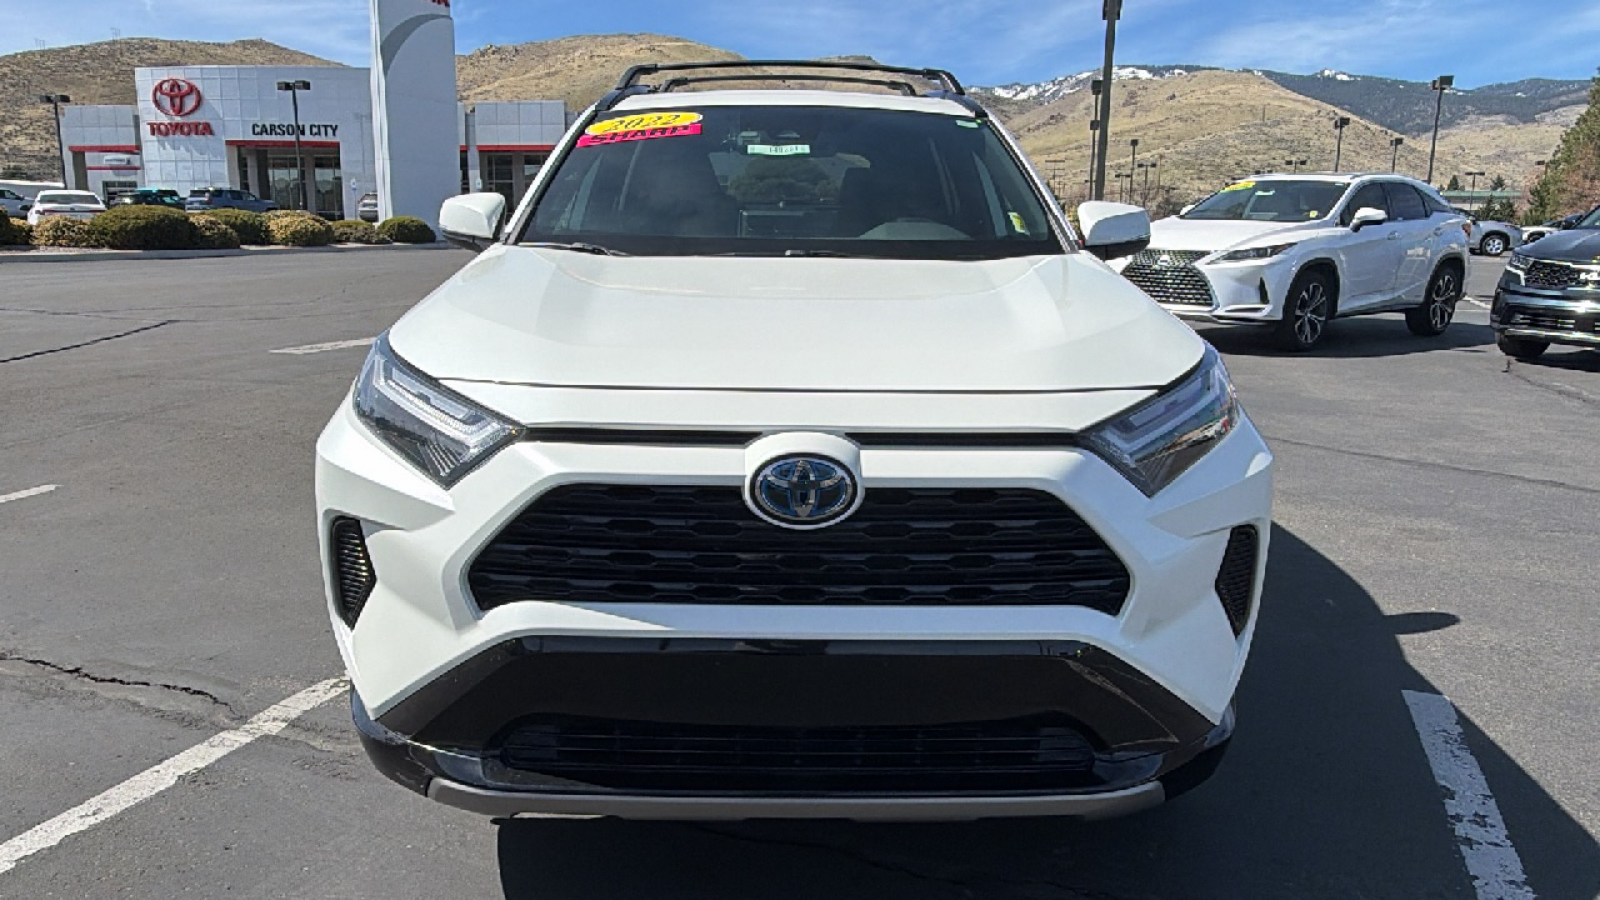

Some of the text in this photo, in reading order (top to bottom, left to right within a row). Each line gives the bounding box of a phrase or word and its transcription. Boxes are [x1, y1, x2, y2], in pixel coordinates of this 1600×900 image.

[147, 122, 215, 137] TOYOTA
[252, 124, 339, 137] CARSON CITY
[588, 124, 690, 142] SHARP
